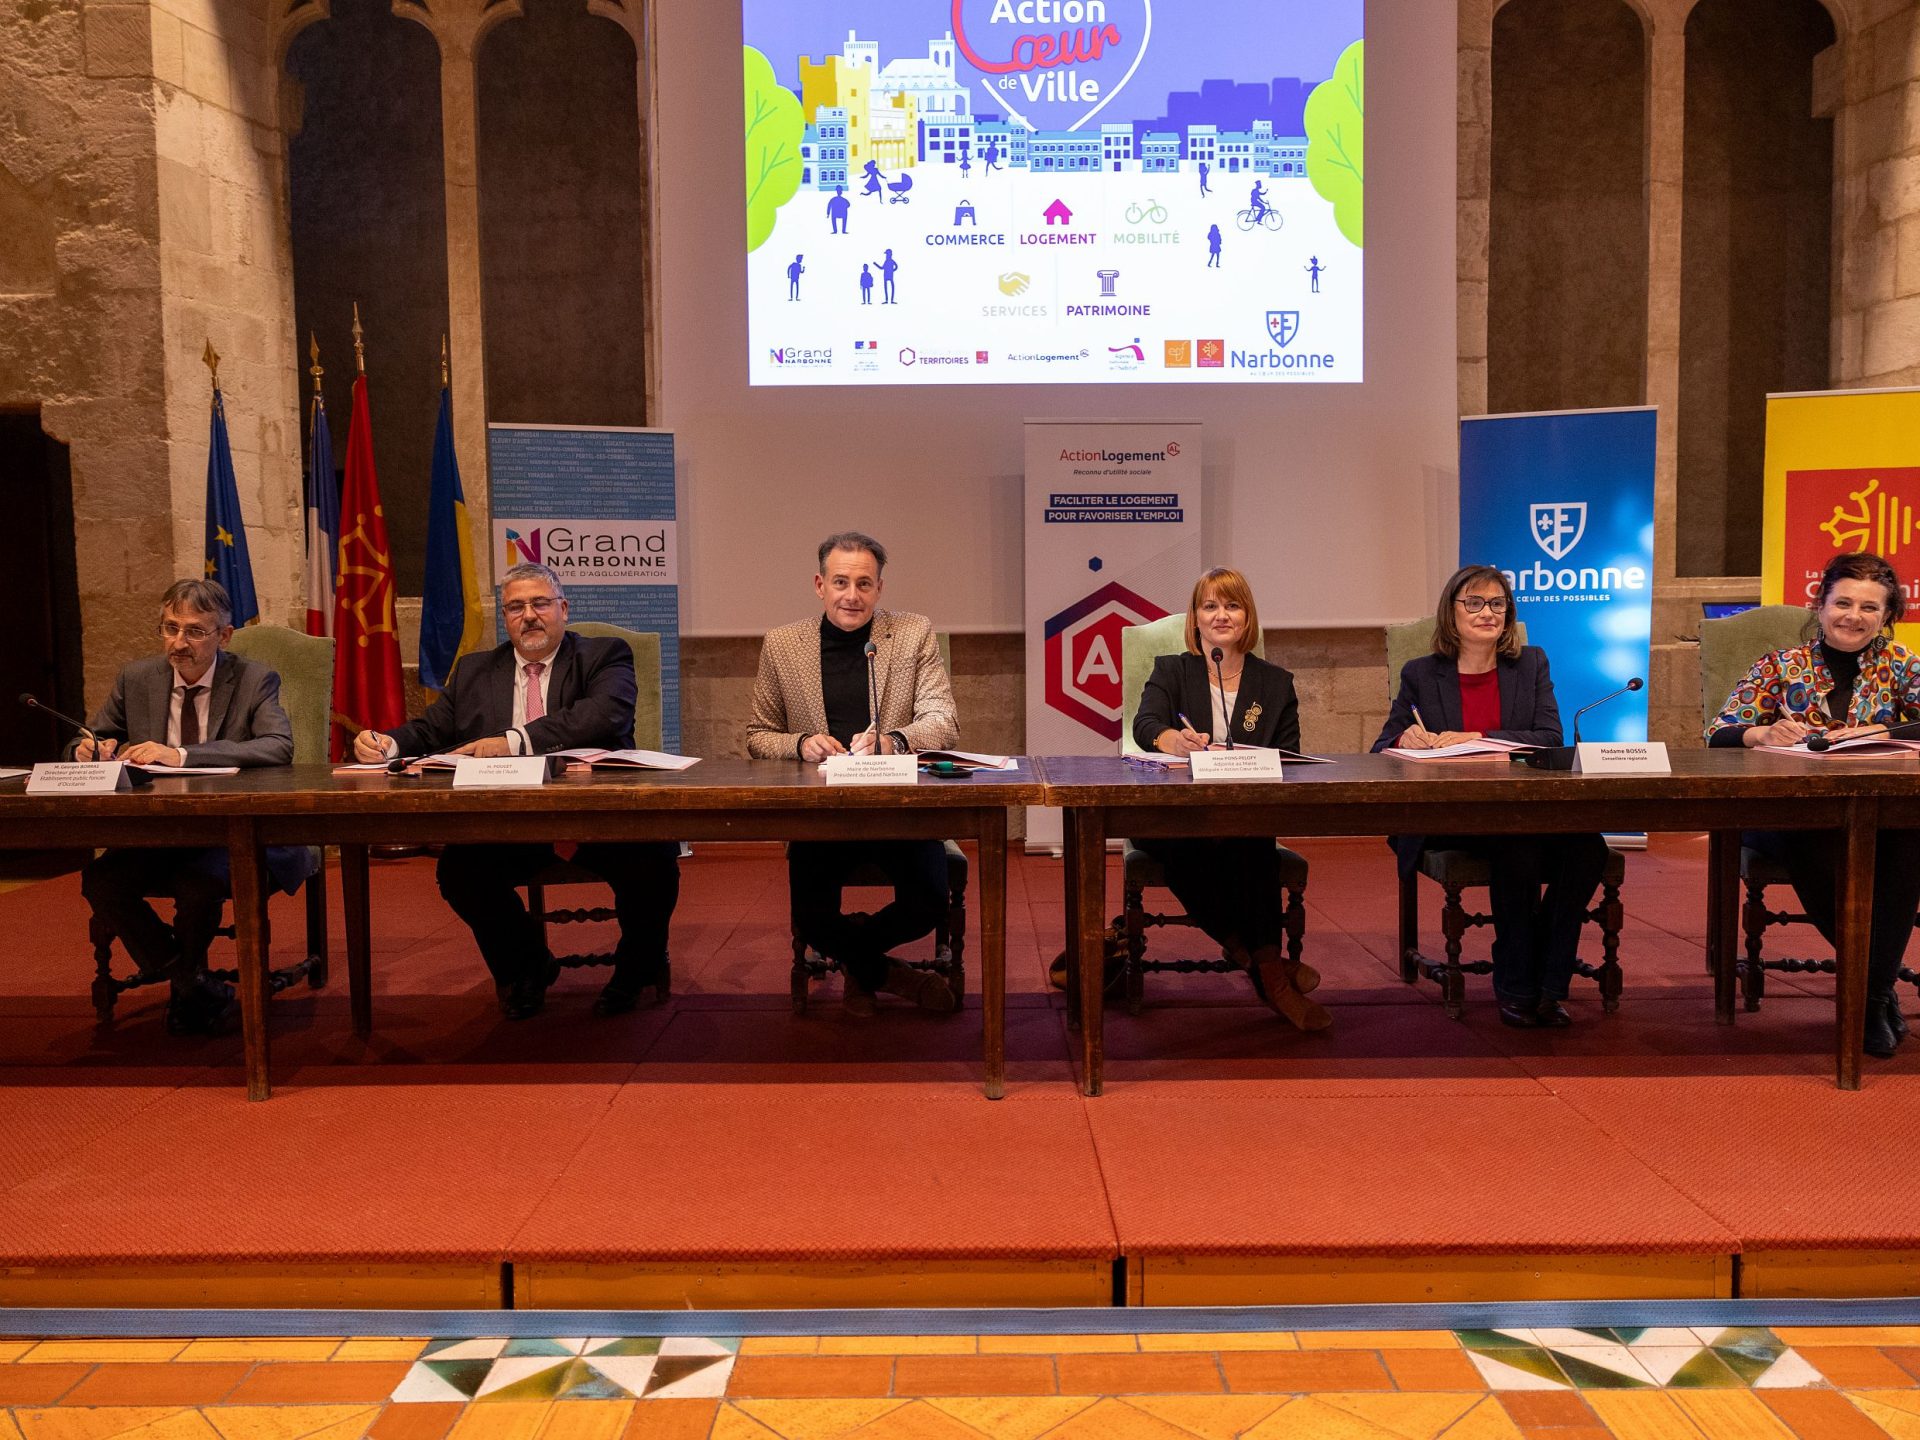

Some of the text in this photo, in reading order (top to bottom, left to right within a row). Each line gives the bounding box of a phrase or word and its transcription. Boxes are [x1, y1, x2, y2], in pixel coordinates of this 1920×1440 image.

[990, 0, 1106, 24] Action
[998, 70, 1099, 102] de Ville
[925, 234, 1006, 246] COMMERCE
[1019, 233, 1097, 245] LOGEMENT
[1113, 230, 1181, 244] MOBILITÉ
[981, 305, 1048, 317] SERVICES
[1066, 305, 1151, 316] PATRIMOINE
[785, 347, 832, 358] Grand
[1231, 349, 1335, 368] Narbonne
[919, 357, 969, 365] TERRITOIRES
[1054, 496, 1174, 505] FACILITER LE LOGEMENT
[1049, 511, 1180, 521] POUR FAVORISER L'EMPLOI
[547, 528, 666, 553] Grand
[547, 556, 666, 567] NARBONNE
[580, 569, 667, 577] D'AGGLOMÉRATION
[1491, 560, 1646, 591] arbonne
[1805, 570, 1818, 578] La
